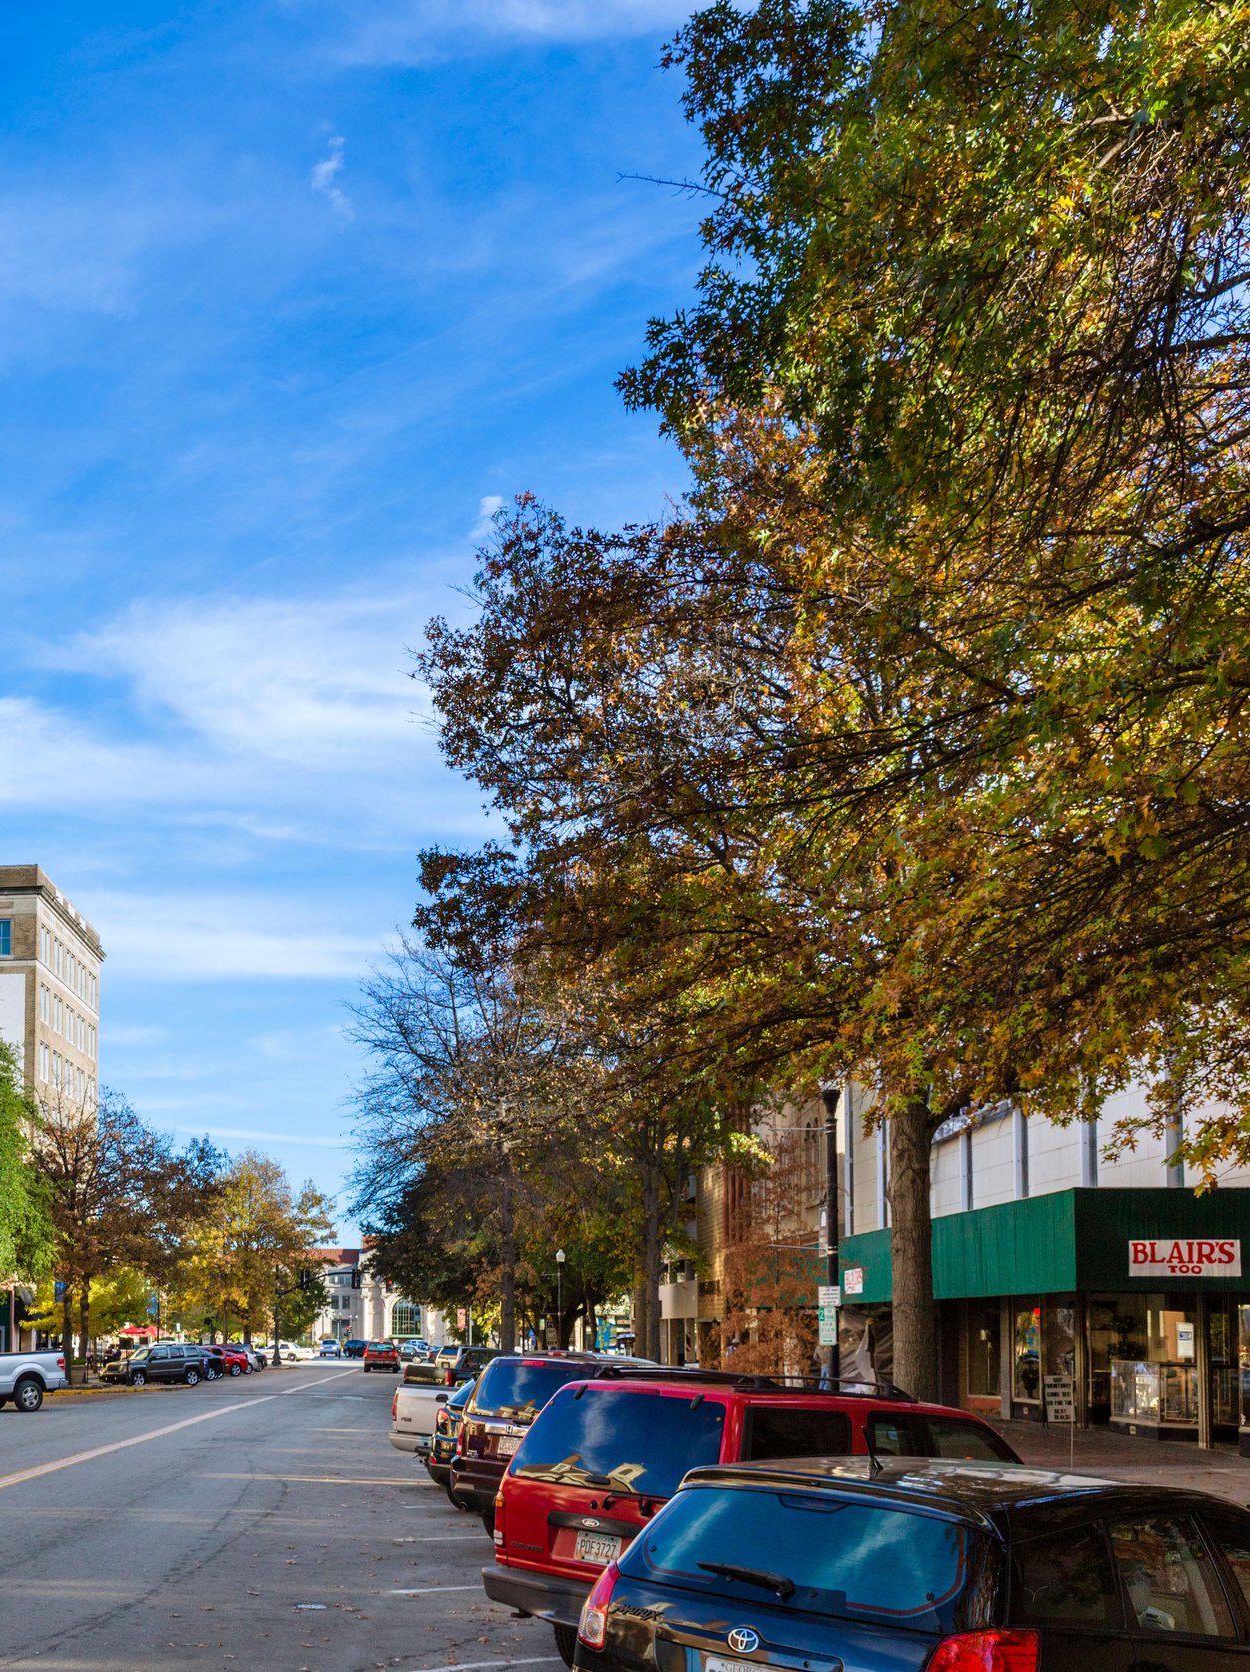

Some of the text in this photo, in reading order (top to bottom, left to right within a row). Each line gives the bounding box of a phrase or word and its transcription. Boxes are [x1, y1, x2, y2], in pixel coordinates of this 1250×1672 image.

[1132, 1241, 1235, 1264] BLAIR'S
[1167, 1265, 1202, 1274] TOO
[580, 1539, 616, 1558] PDF3727
